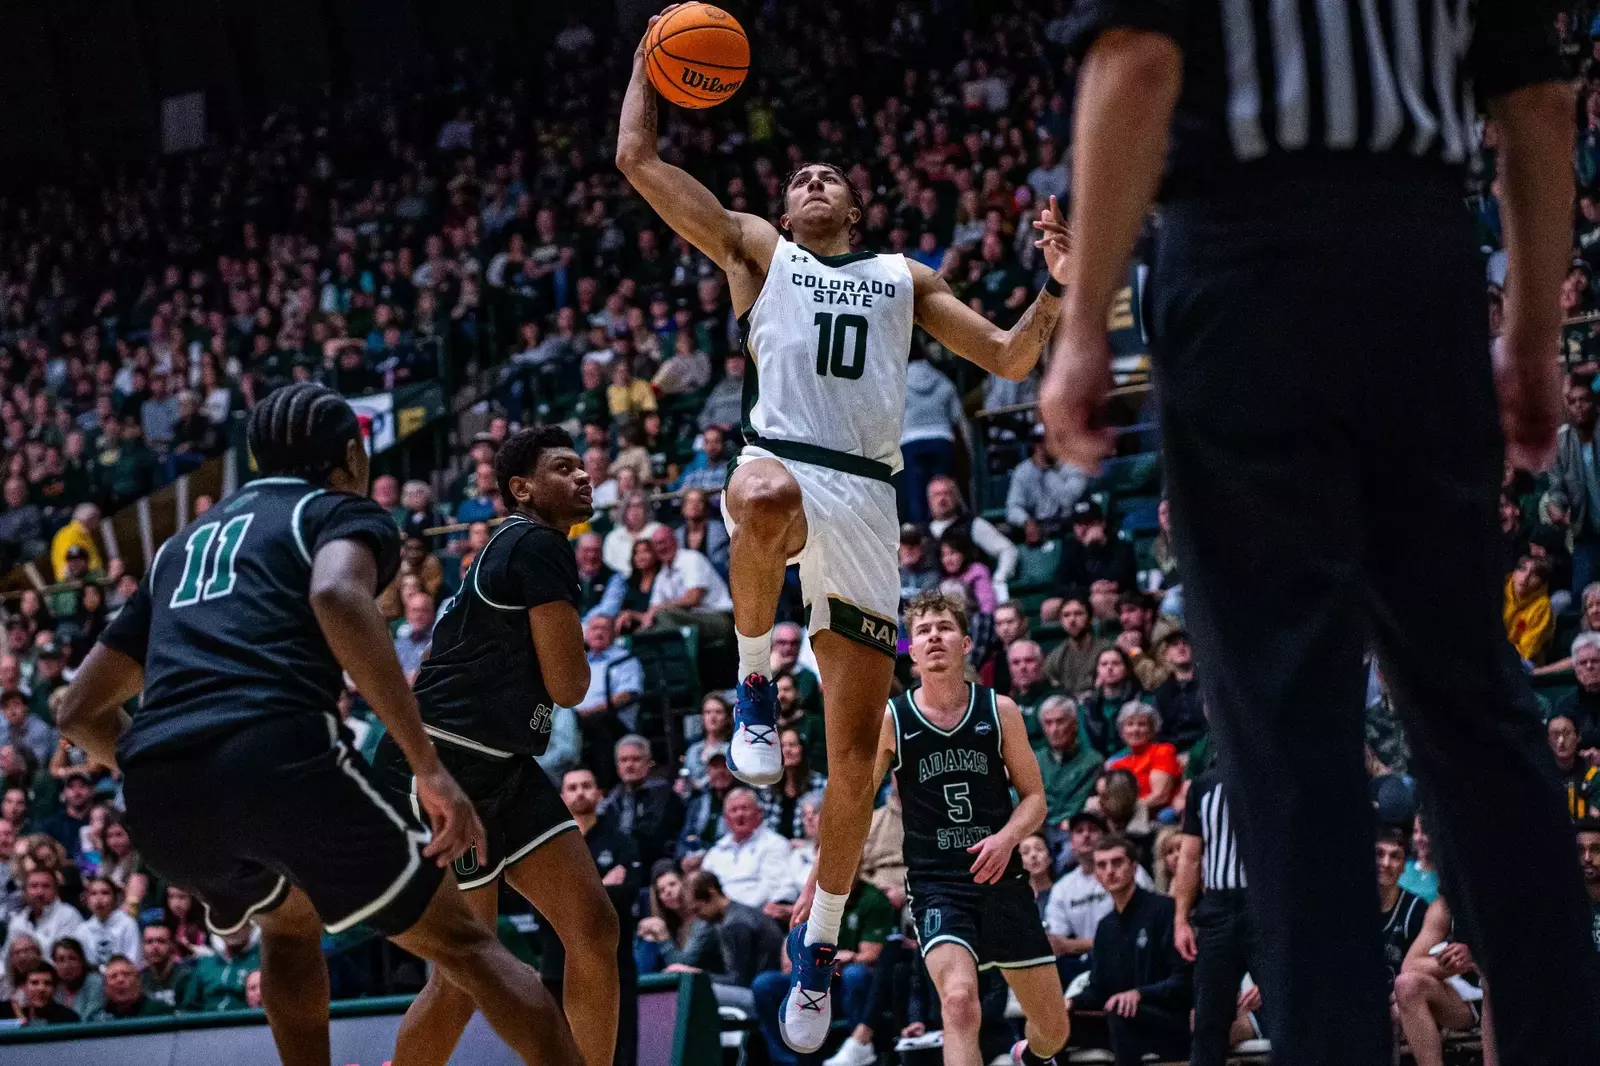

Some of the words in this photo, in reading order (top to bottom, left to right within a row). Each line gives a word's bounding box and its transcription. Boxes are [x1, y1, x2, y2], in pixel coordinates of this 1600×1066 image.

[682, 67, 740, 93] Wilson
[792, 273, 895, 298] COLORADO
[813, 290, 873, 308] STATE
[814, 312, 869, 380] 10
[169, 512, 255, 610] 11
[918, 748, 989, 783] ADAMS
[942, 781, 973, 823] 5
